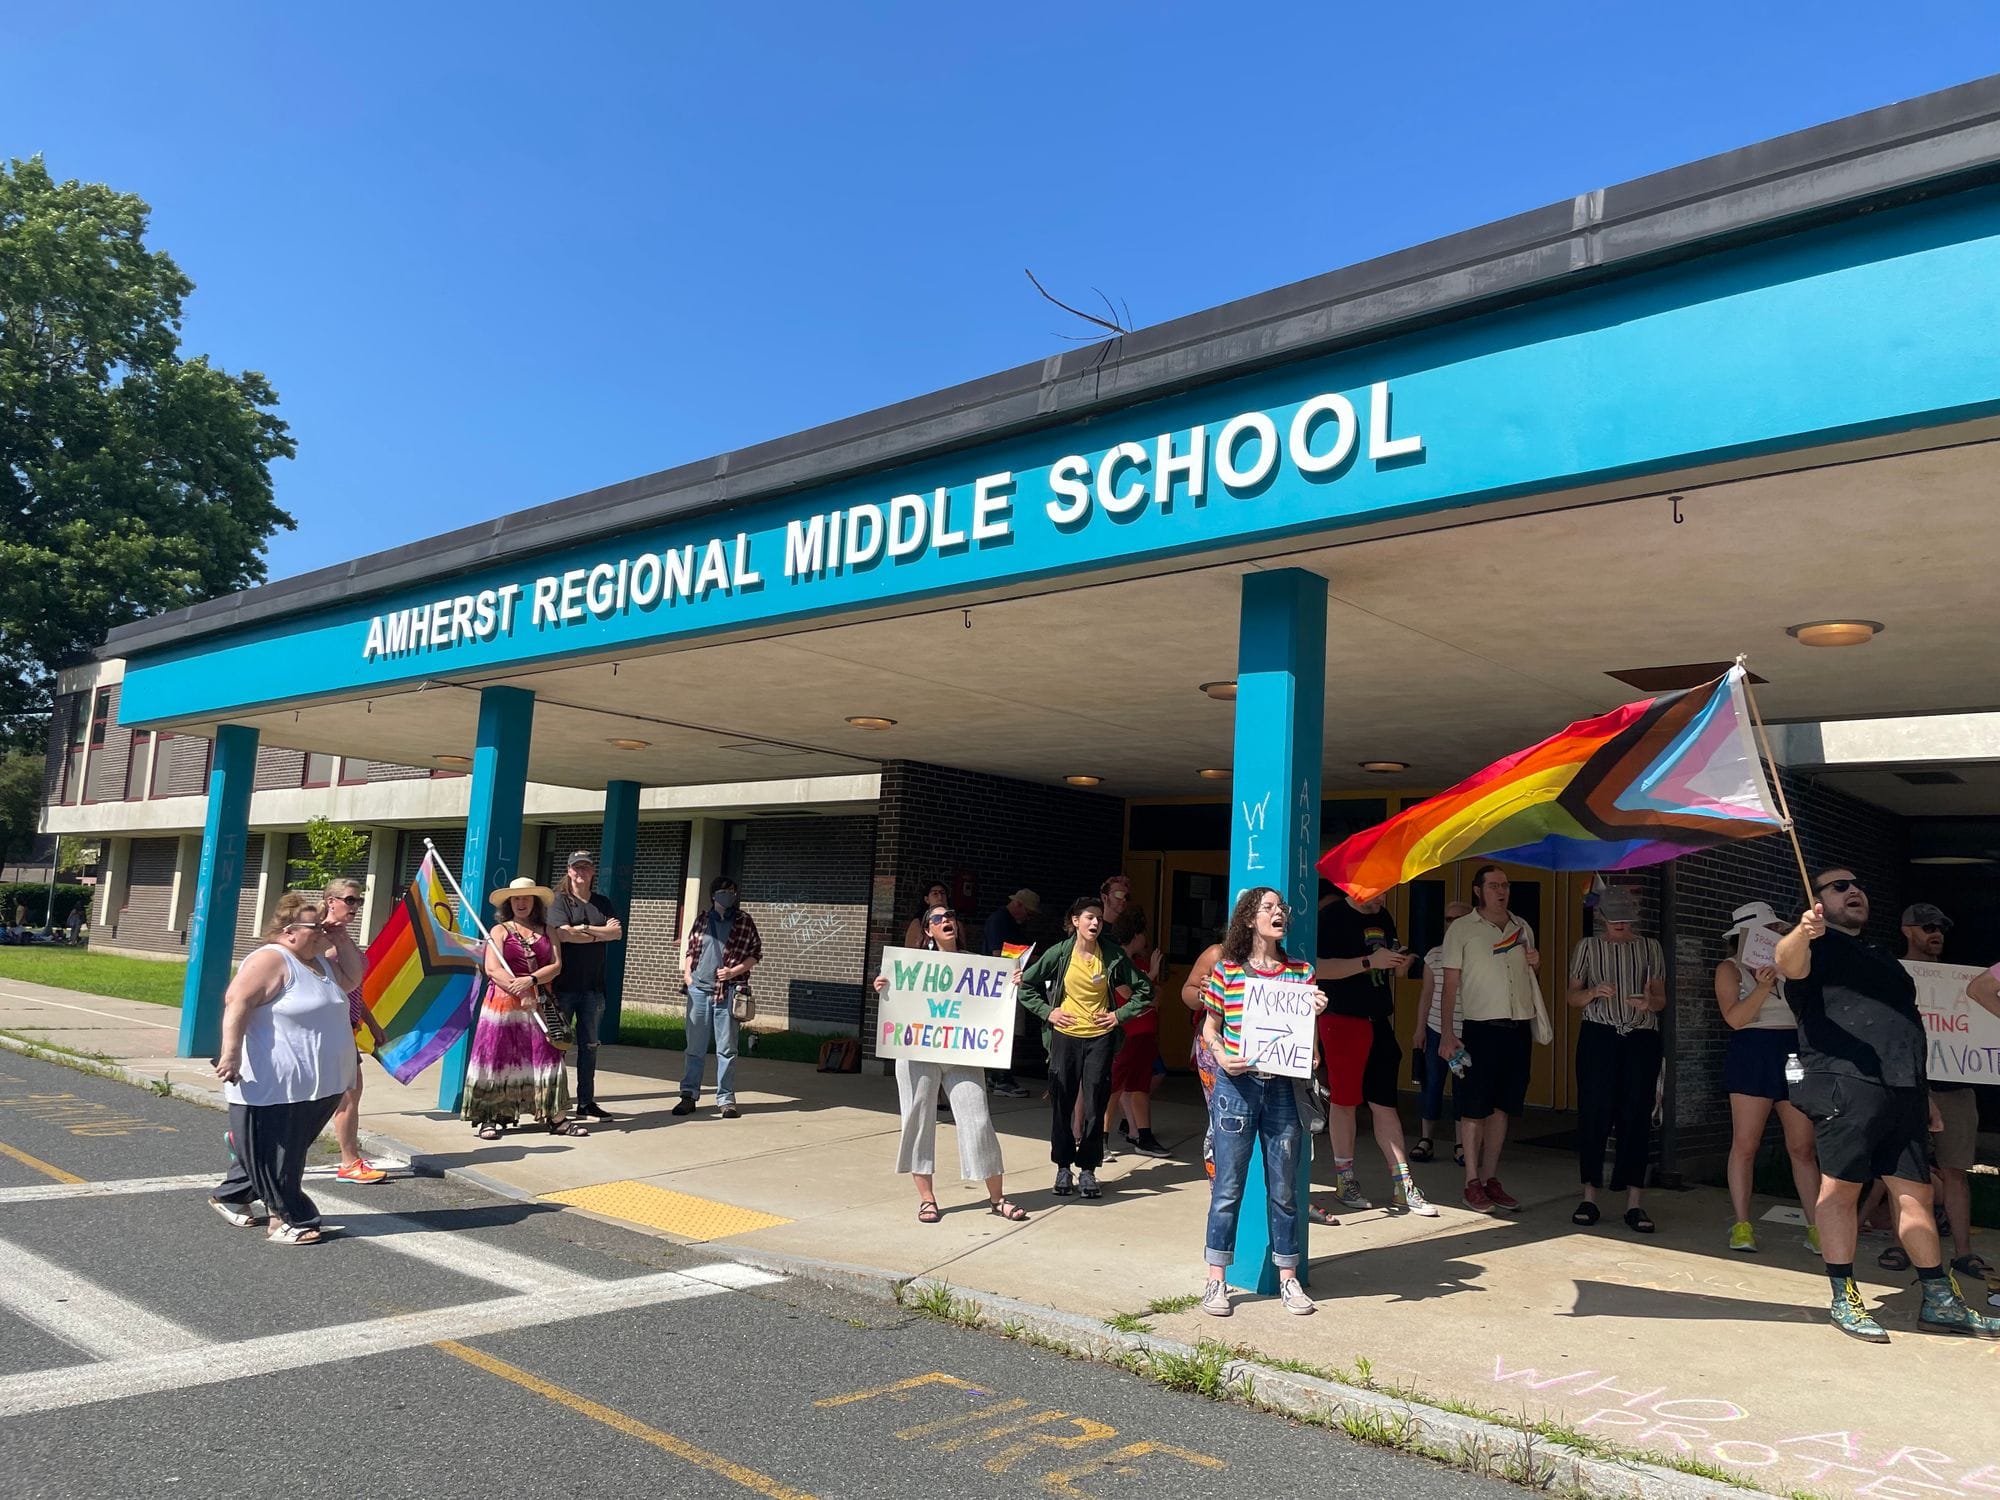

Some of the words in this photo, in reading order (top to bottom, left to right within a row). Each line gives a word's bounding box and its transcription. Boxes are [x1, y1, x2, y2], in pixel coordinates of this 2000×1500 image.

[363, 584, 519, 658] AMHERST
[532, 532, 761, 625] REGIONAL
[784, 471, 1012, 577] MIDDLE
[1045, 381, 1422, 525] SCHOOL
[894, 960, 954, 992] WHO
[954, 967, 1007, 998] ARE
[927, 998, 962, 1019] WE
[1247, 984, 1313, 1016] MORRIS
[881, 1021, 1004, 1053] PROTECTING?
[1929, 1040, 1949, 1074] A
[1492, 1354, 1750, 1422] WHO
